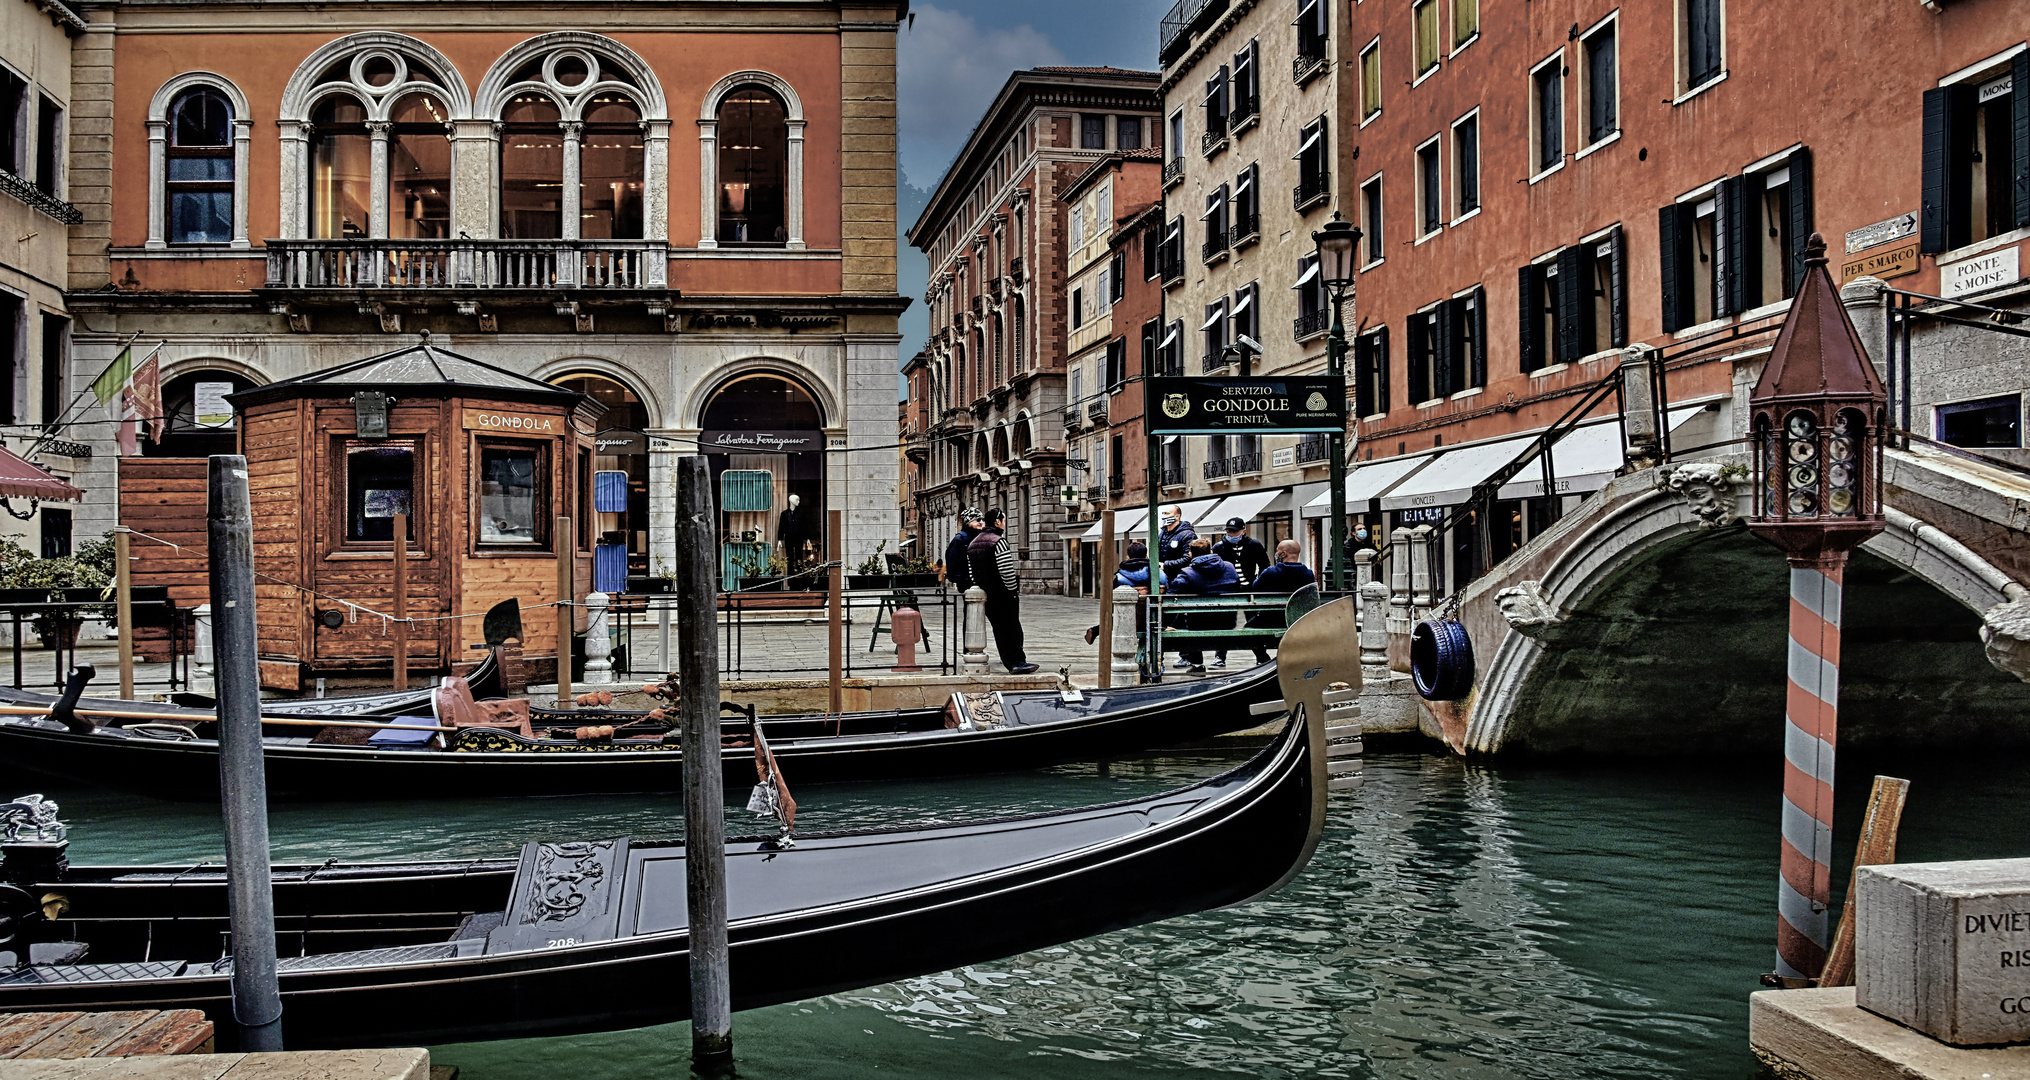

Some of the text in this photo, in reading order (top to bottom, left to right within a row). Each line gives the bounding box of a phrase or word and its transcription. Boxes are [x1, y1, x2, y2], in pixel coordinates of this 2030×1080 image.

[1845, 263, 1864, 276] PER
[1957, 256, 2000, 277] PONTE
[1954, 281, 1963, 292] S.
[1222, 386, 1272, 396] SERVIZIO
[1203, 399, 1289, 412] GONDOLE
[478, 414, 552, 430] GONDOLA
[1225, 413, 1270, 424] TRINITÀ
[715, 433, 810, 450] Salvatore Ferragamo
[1411, 495, 1436, 506] MONCLER
[548, 937, 575, 948] 208
[2001, 949, 2030, 968] RIS
[2000, 996, 2030, 1014] GO
